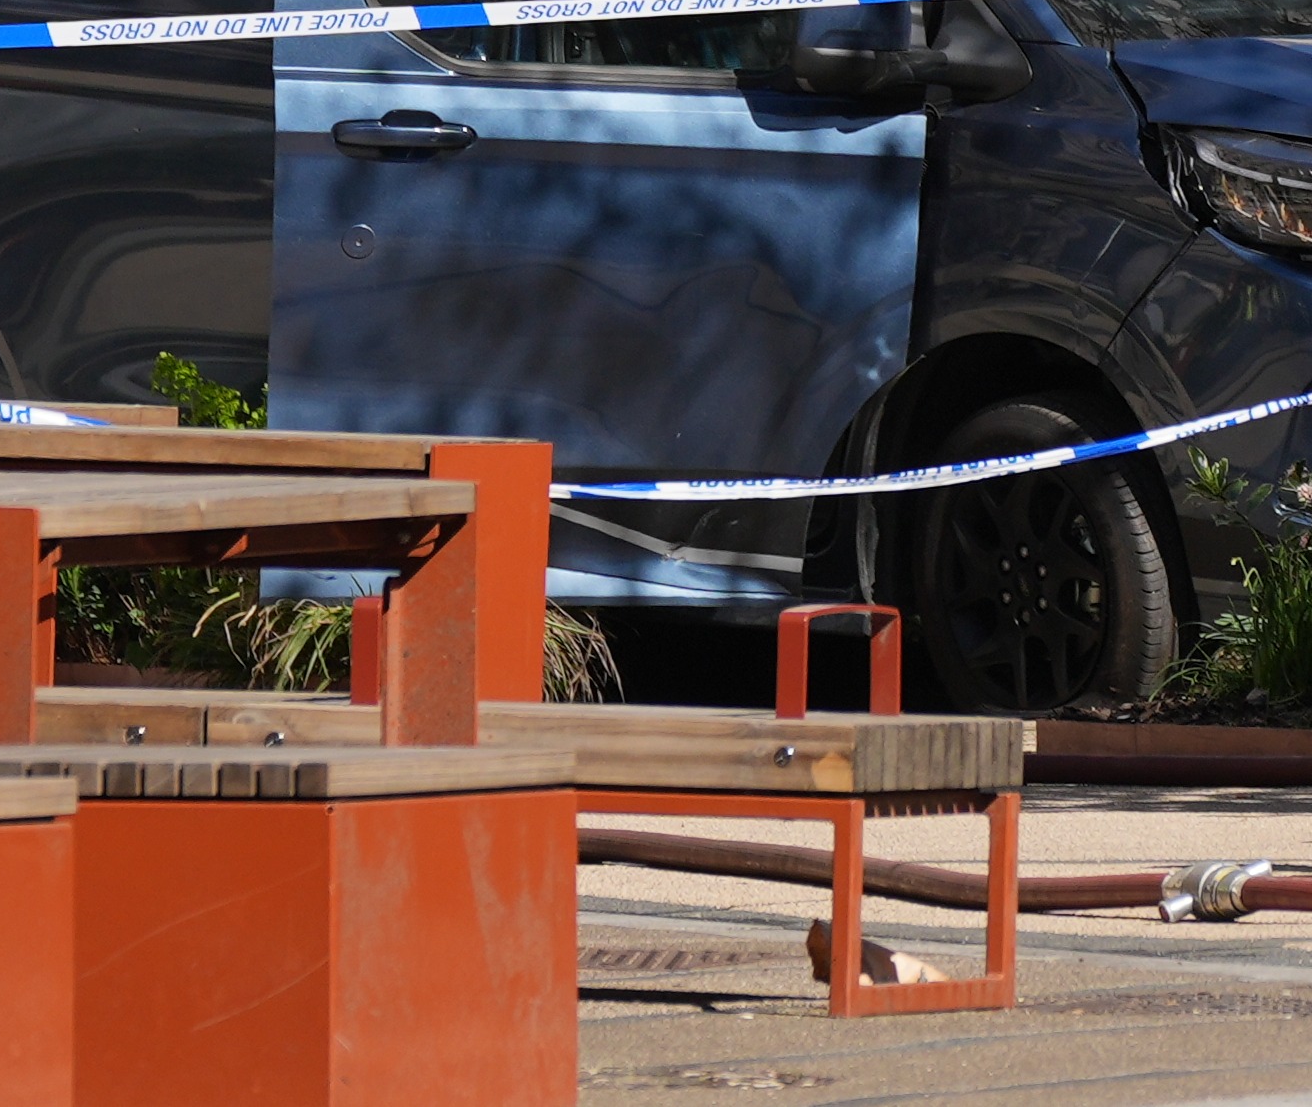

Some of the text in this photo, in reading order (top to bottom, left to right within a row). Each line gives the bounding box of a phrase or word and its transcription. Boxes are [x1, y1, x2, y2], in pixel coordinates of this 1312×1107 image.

[516, 2, 592, 20] CROSS
[598, 0, 643, 15] NOT
[80, 11, 389, 41] POLICE LINE DO NOT CROSS
